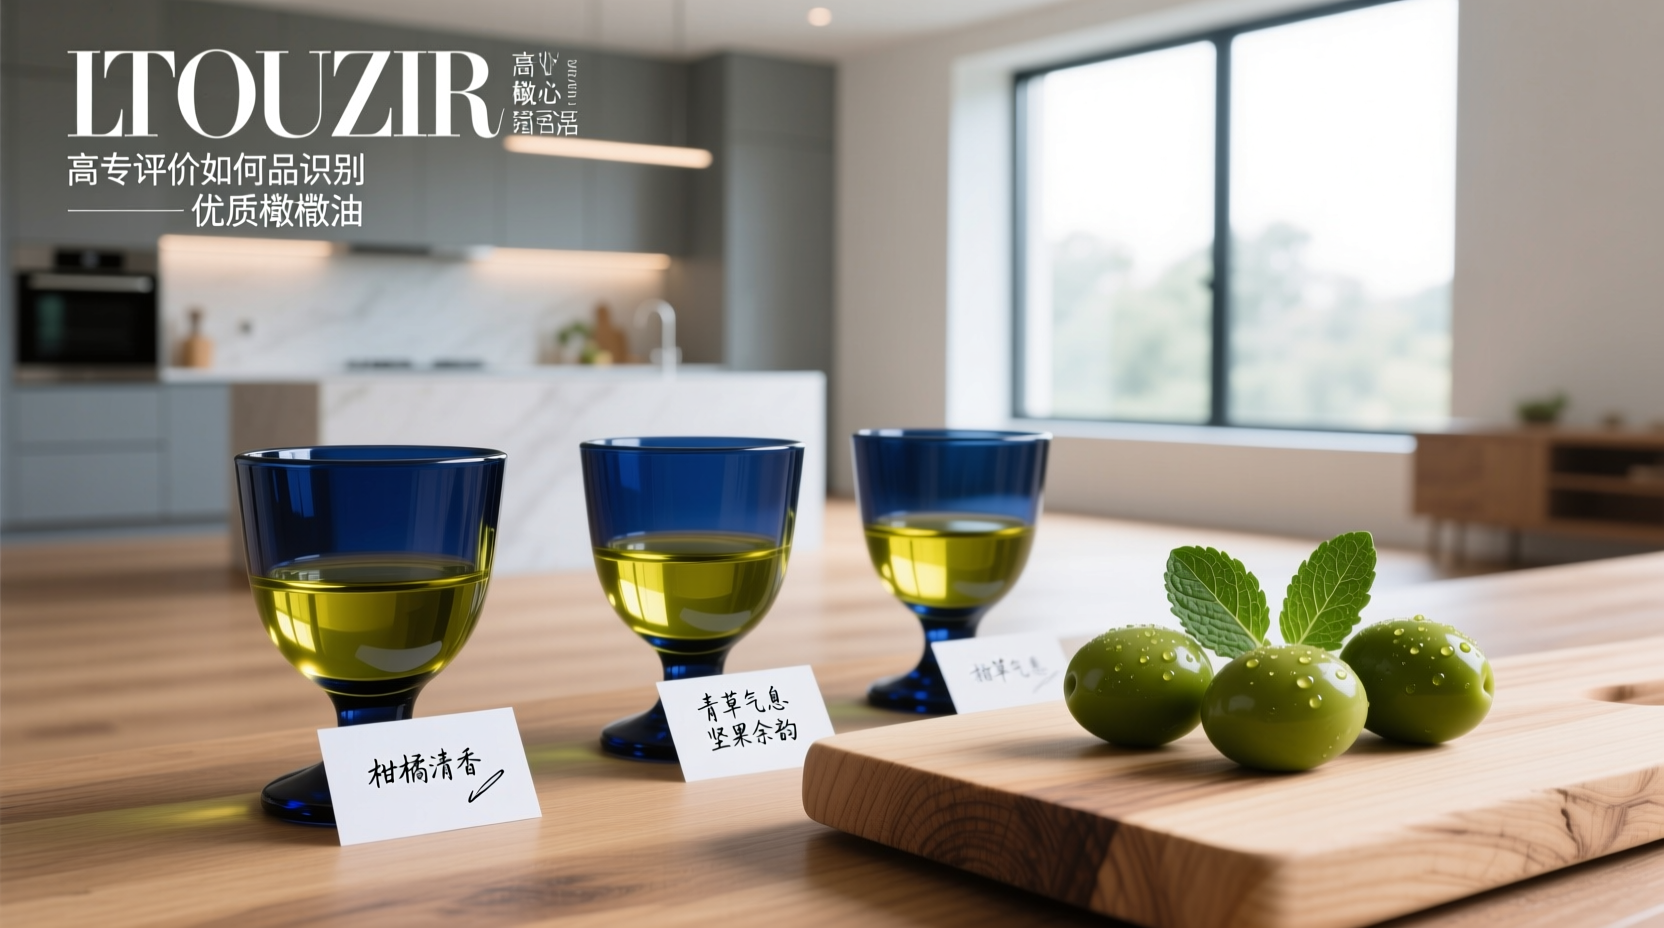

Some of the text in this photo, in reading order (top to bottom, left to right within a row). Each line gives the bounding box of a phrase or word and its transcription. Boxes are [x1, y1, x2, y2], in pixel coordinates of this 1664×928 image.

[697, 685, 789, 722] 青草气息
[707, 718, 798, 752] 坚果余韵
[367, 747, 481, 789] 柑橘清香
